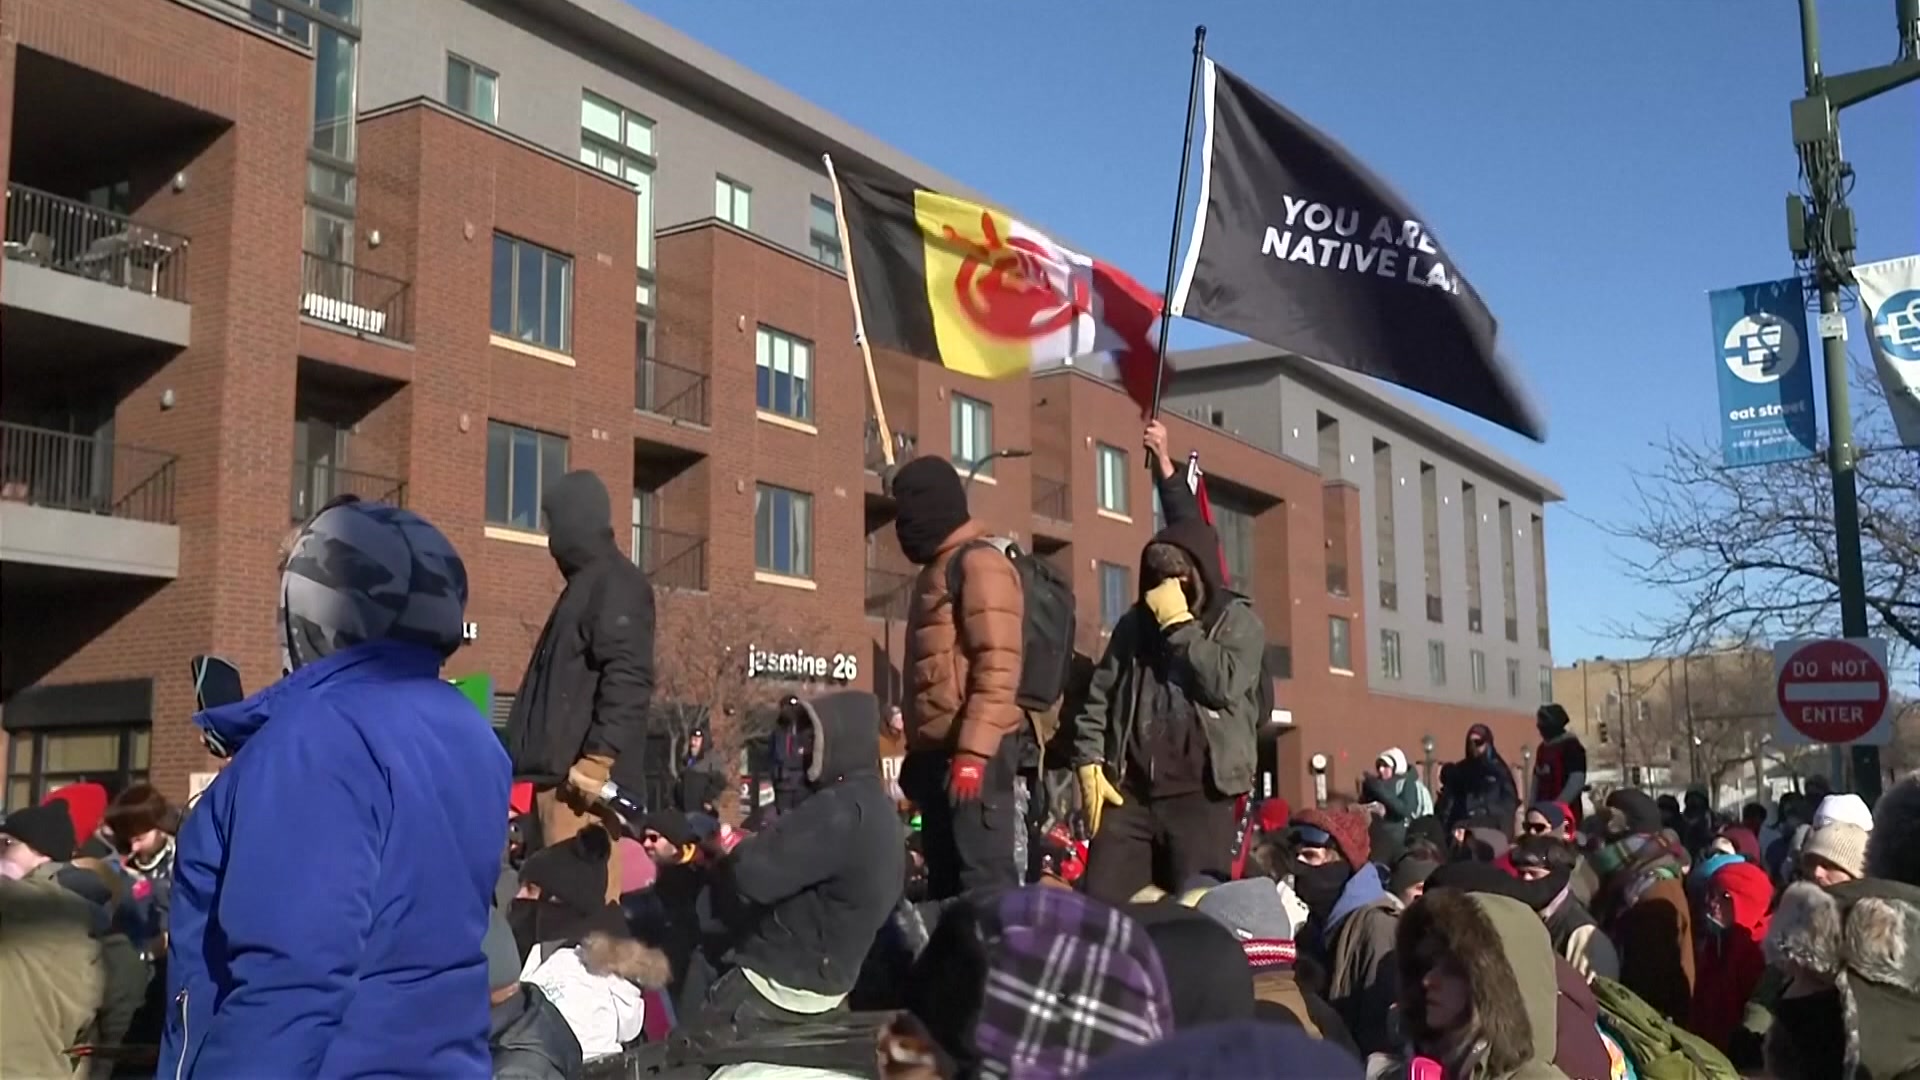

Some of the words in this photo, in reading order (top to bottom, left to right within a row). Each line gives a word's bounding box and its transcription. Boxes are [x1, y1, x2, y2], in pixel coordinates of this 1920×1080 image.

[1283, 195, 1359, 237] YOU
[1261, 226, 1399, 278] NATIVE
[1729, 406, 1756, 421] eat
[748, 643, 827, 677] jasmine
[833, 653, 857, 680] 26
[1793, 661, 1818, 677] DO
[1831, 660, 1868, 676] NOT
[1802, 706, 1863, 722] ENTER
